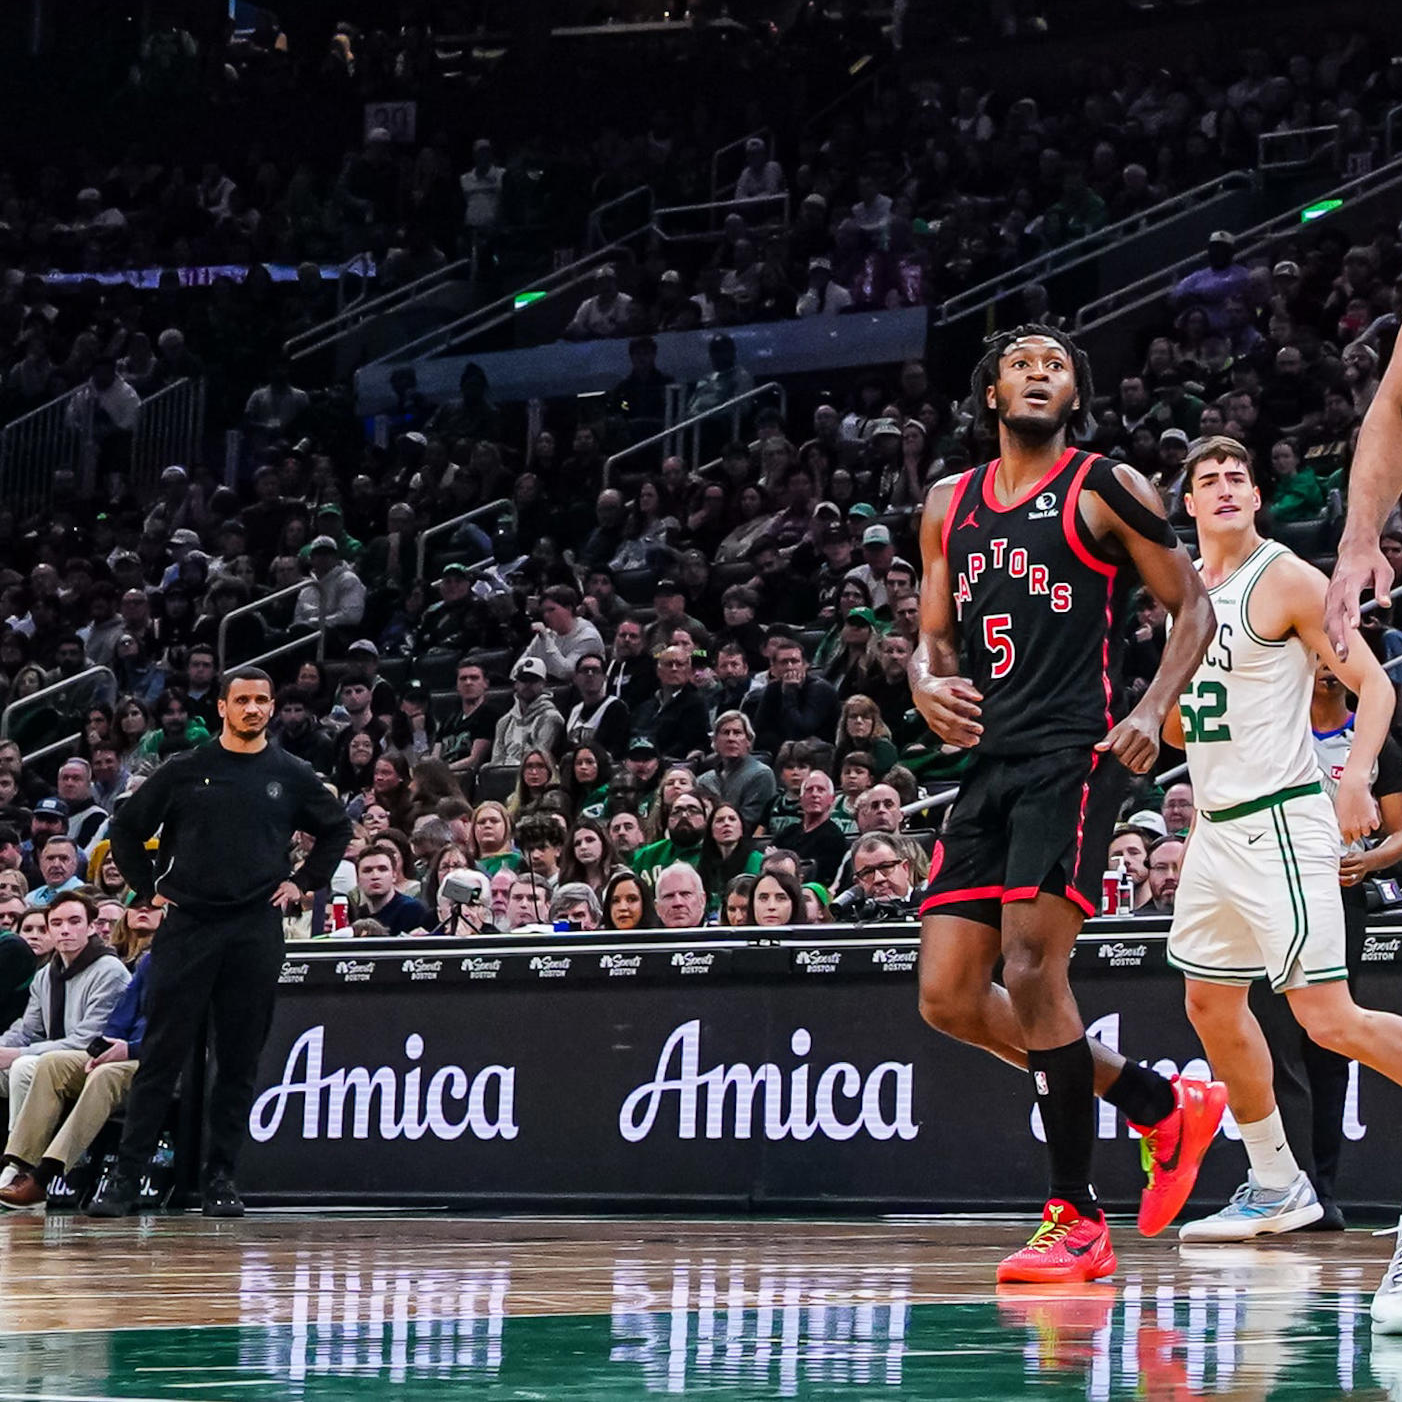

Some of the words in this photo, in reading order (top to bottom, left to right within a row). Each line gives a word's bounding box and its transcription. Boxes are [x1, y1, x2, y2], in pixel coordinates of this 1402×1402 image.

[983, 613, 1015, 679] 5
[1114, 943, 1147, 957] Sports
[1364, 938, 1400, 952] Sports
[613, 954, 642, 968] Sports
[686, 952, 715, 966] Sports
[811, 950, 842, 964] Sports
[887, 948, 918, 962] Sports
[1110, 957, 1141, 966] BOSTON
[1362, 952, 1395, 961] BOSTON
[281, 963, 310, 976] Sports
[348, 961, 375, 975] Sports
[414, 959, 443, 972] Sports
[474, 957, 502, 971] Sports
[543, 956, 572, 970] Sports
[681, 965, 709, 974] BOSTON
[807, 963, 836, 972] BOSTON
[883, 962, 913, 971] BOSTON
[344, 974, 371, 982] BOSTON
[411, 972, 437, 980] BOSTON
[470, 971, 496, 979] BOSTON
[539, 969, 566, 977] BOSTON
[610, 968, 637, 976] BOSTON
[250, 1024, 519, 1142] Amica
[619, 1019, 919, 1142] Amica
